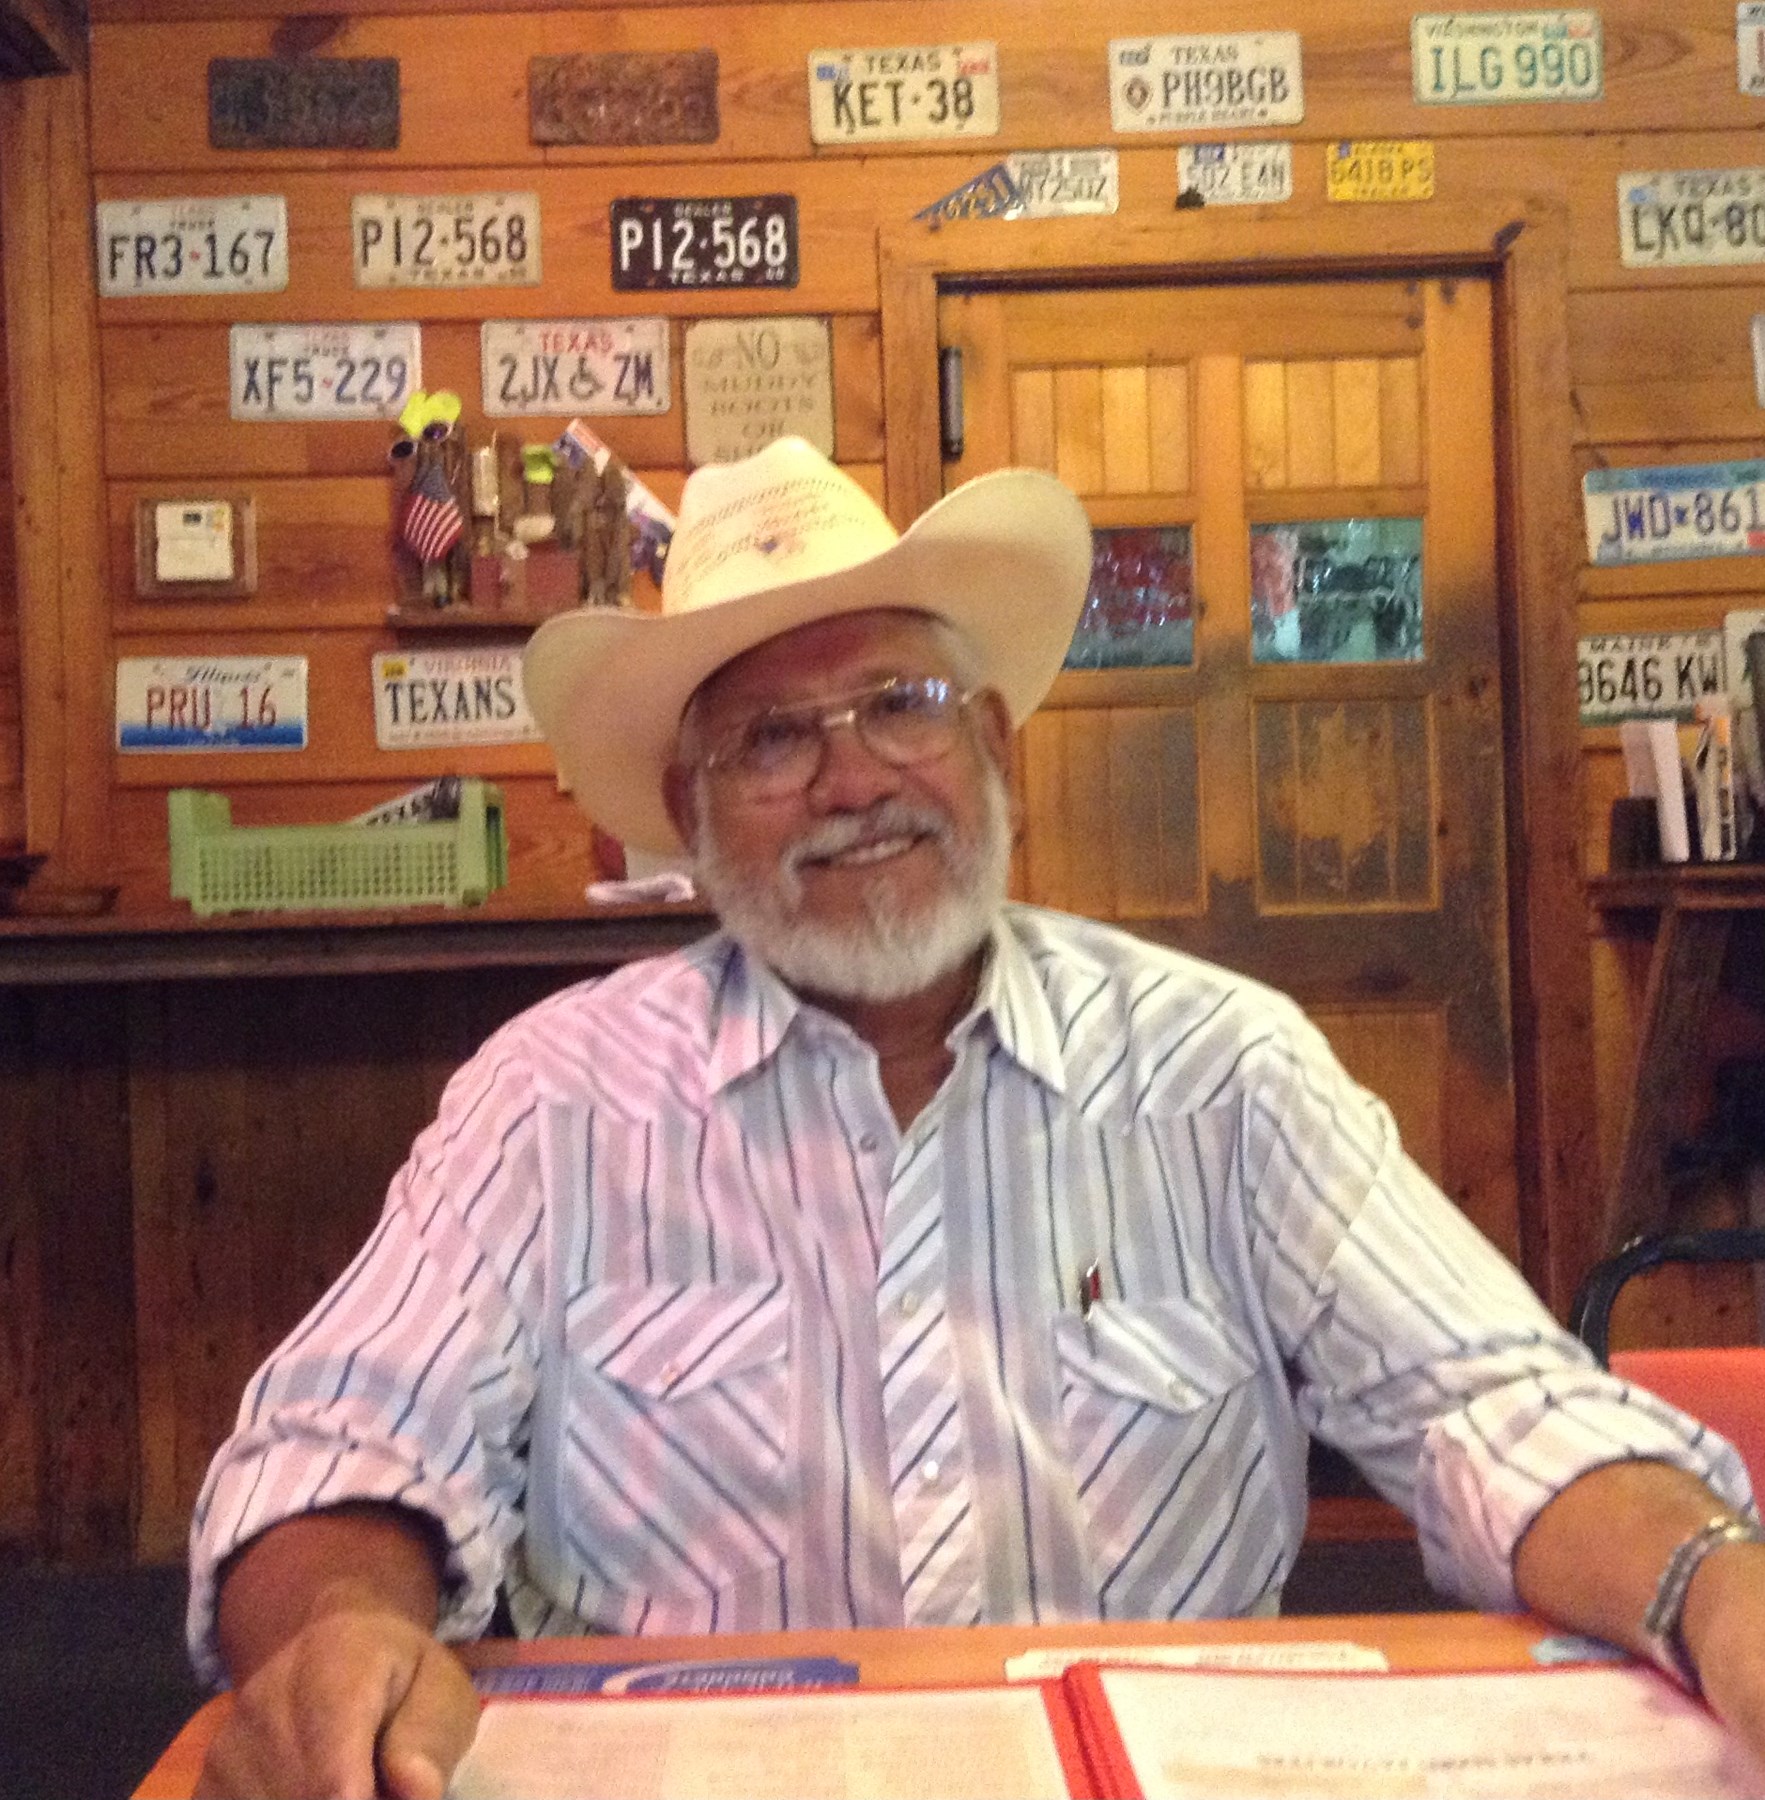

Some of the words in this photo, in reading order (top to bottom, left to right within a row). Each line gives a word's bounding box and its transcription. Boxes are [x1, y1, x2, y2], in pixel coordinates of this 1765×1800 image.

[864, 53, 942, 75] TEXAS
[1171, 44, 1239, 65] TEXAS
[1432, 47, 1503, 92] ILG
[1514, 43, 1592, 88] 990
[1162, 66, 1290, 108] PH9BGB
[1675, 177, 1752, 196] TEXAS
[539, 331, 615, 354] TEXAS
[735, 328, 780, 371] NO
[500, 353, 560, 401] 2JX
[613, 352, 654, 400] ZM
[704, 373, 817, 393] MUDDY
[711, 396, 814, 417] BOOTS
[146, 685, 211, 729] PRU
[240, 685, 277, 729] 16
[384, 676, 516, 725] TEXANS
